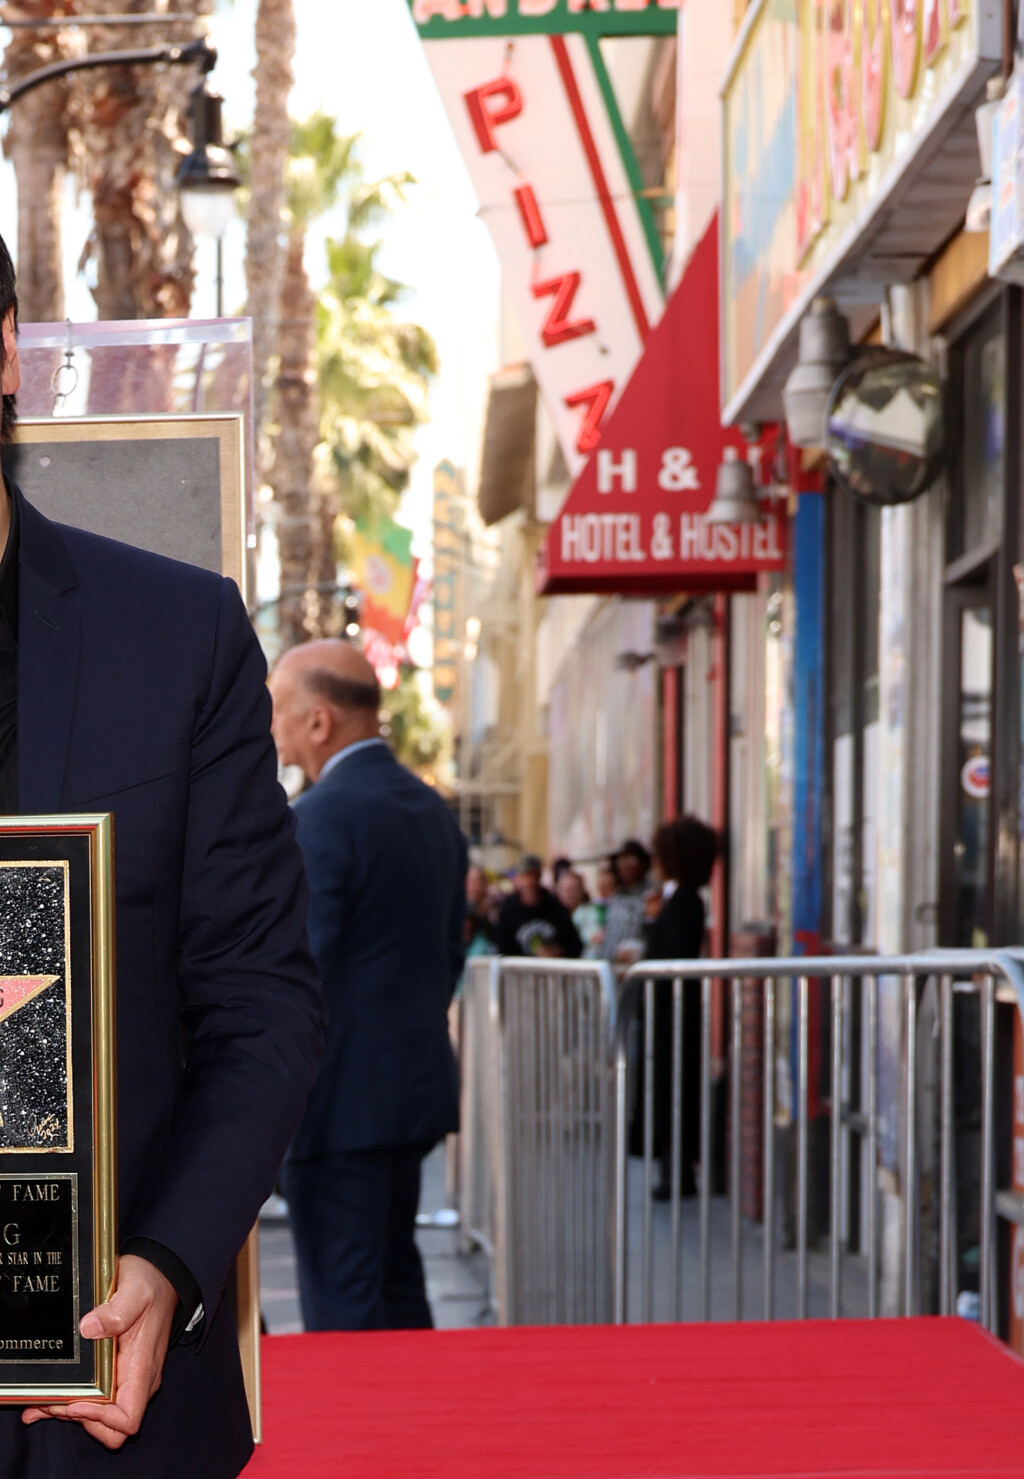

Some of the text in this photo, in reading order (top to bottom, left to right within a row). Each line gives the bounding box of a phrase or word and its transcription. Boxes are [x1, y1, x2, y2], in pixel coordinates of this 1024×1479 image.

[597, 448, 637, 493] H
[653, 446, 700, 491] &
[560, 511, 783, 563] HOTEL & HOSTEL
[12, 1183, 60, 1201] FAME
[7, 1251, 29, 1265] STAR
[33, 1251, 43, 1265] IN
[46, 1251, 63, 1265] THE
[12, 1275, 61, 1293] FAME
